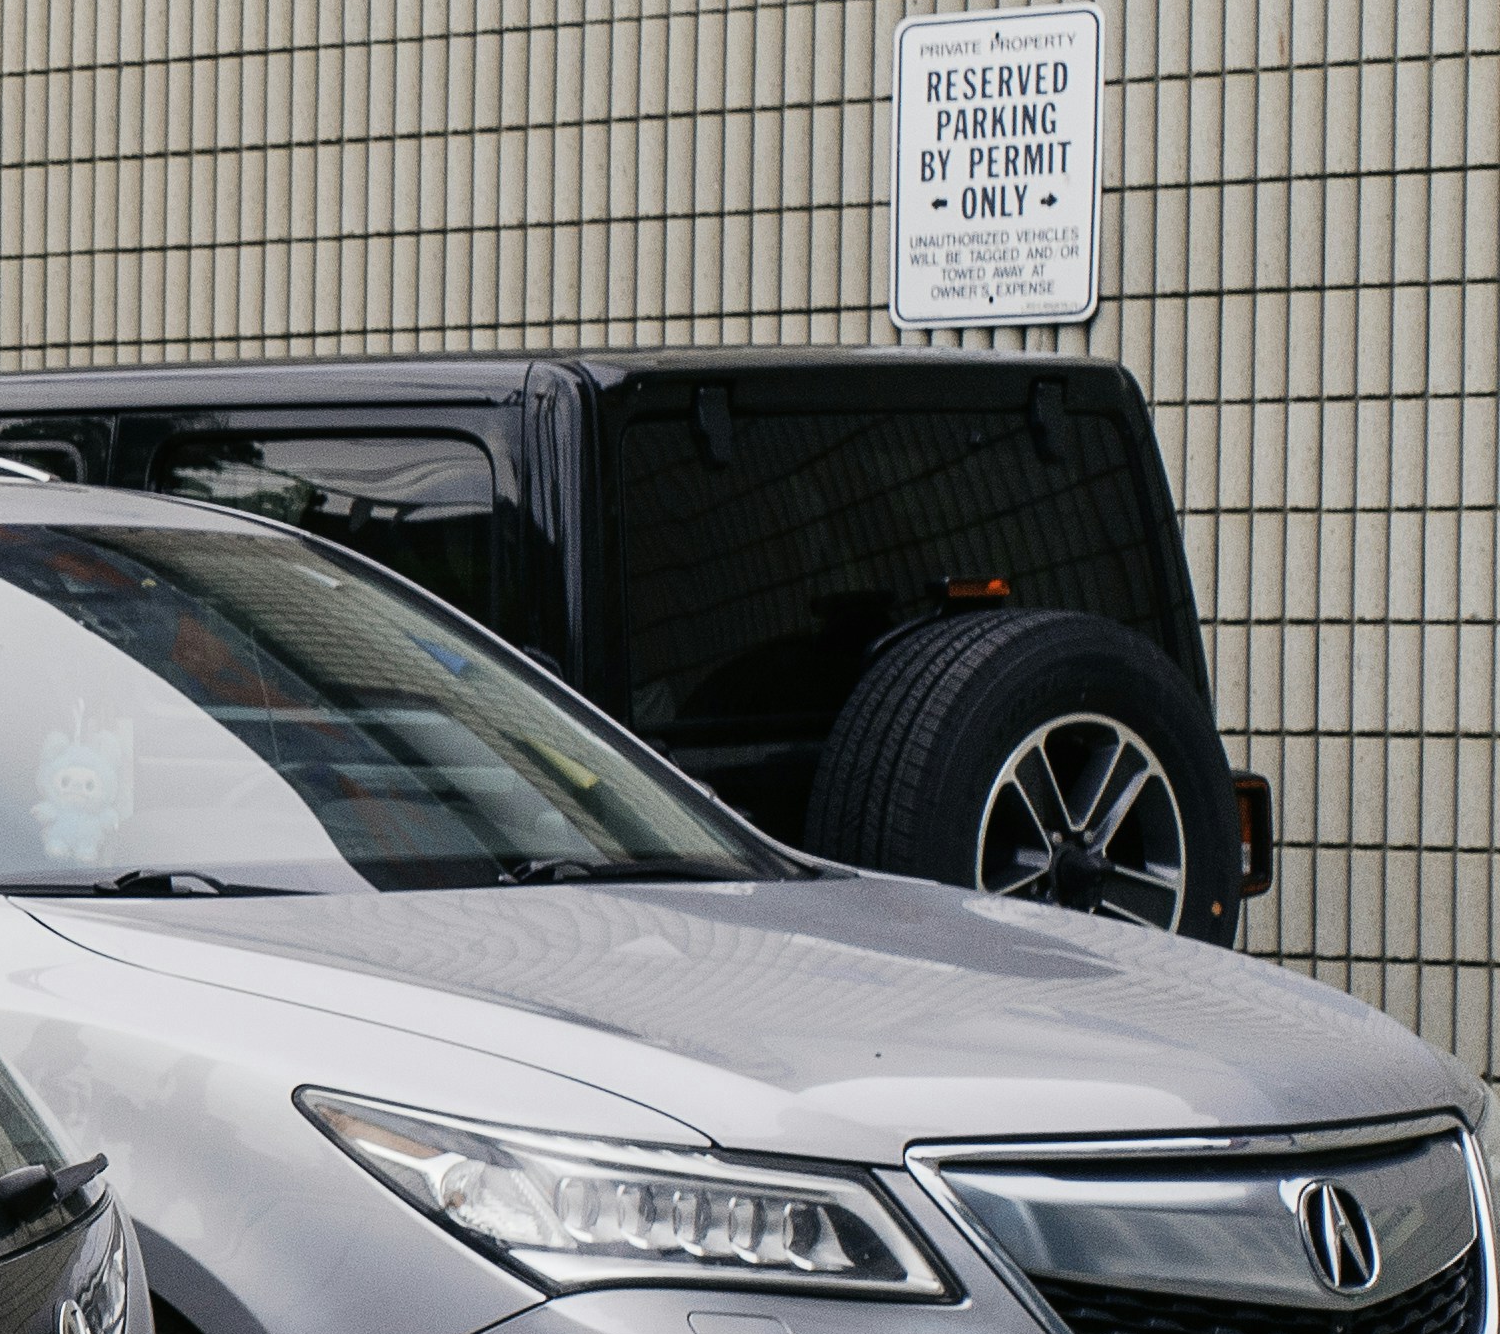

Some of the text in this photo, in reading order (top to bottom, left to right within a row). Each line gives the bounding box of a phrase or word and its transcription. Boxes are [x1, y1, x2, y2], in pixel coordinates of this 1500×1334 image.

[920, 32, 1076, 59] PRIVATE PROPERTY
[927, 61, 1069, 103] RESERVED
[936, 102, 1057, 142] PARKING
[921, 141, 1072, 182] BY PERMIT
[962, 184, 1028, 220] ONLY
[909, 225, 1080, 250] UNAUTHORIZED VEHICLES
[909, 252, 938, 267] WILL
[970, 247, 1020, 264] TAGGED
[942, 264, 1046, 282] TOWED AWAY AT
[996, 280, 1055, 298] EXPENSE
